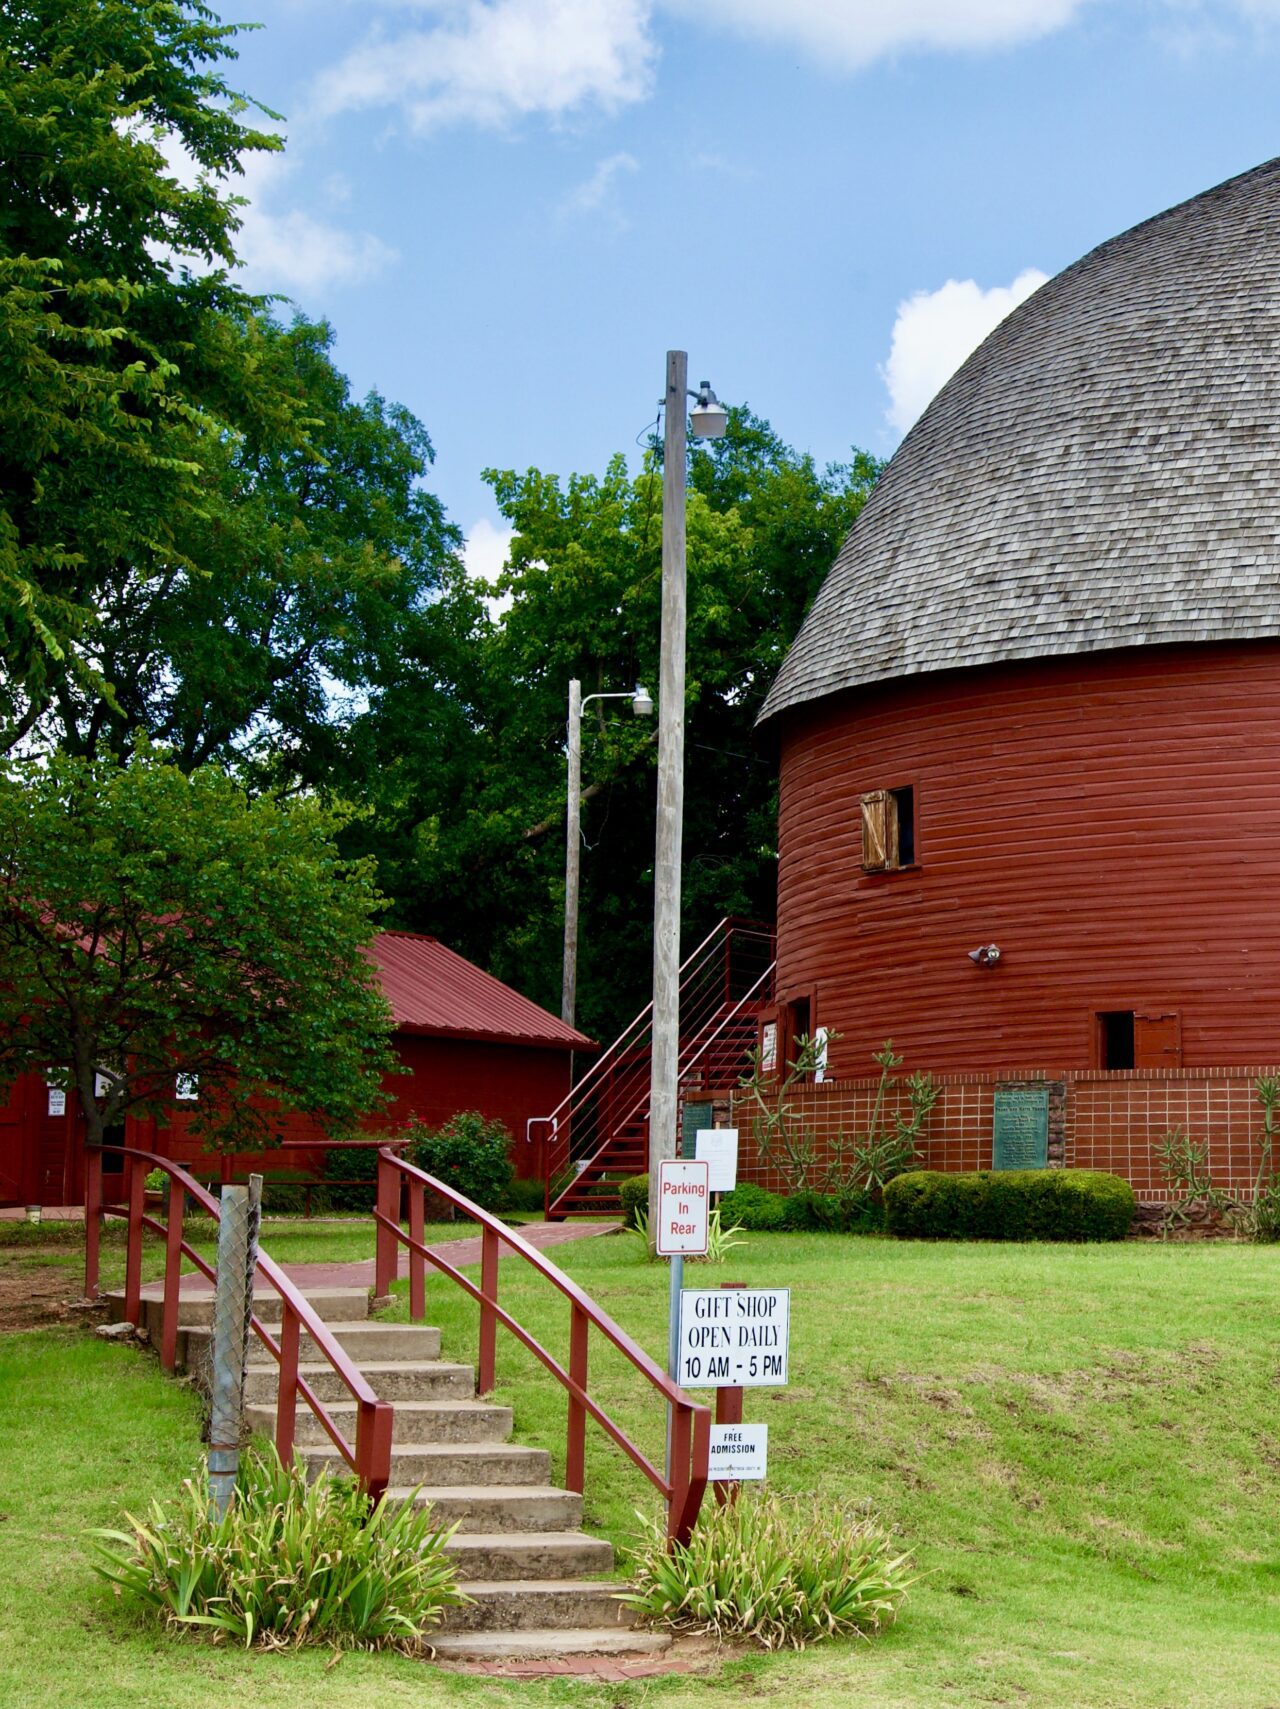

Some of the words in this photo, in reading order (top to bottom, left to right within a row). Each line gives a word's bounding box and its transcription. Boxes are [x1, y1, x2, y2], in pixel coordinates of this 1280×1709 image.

[663, 1182, 705, 1197] Parking
[678, 1202, 689, 1214] In
[670, 1222, 696, 1234] Rear
[695, 1297, 732, 1318] GIFT
[736, 1296, 777, 1318] SHOP
[688, 1326, 732, 1348] OPEN
[738, 1325, 781, 1347] DAILY
[685, 1356, 701, 1378] 10
[707, 1356, 729, 1378] AM
[749, 1355, 757, 1377] 5
[763, 1355, 782, 1376] PM
[723, 1433, 743, 1442] FREE
[711, 1444, 755, 1454] ADMISSION
